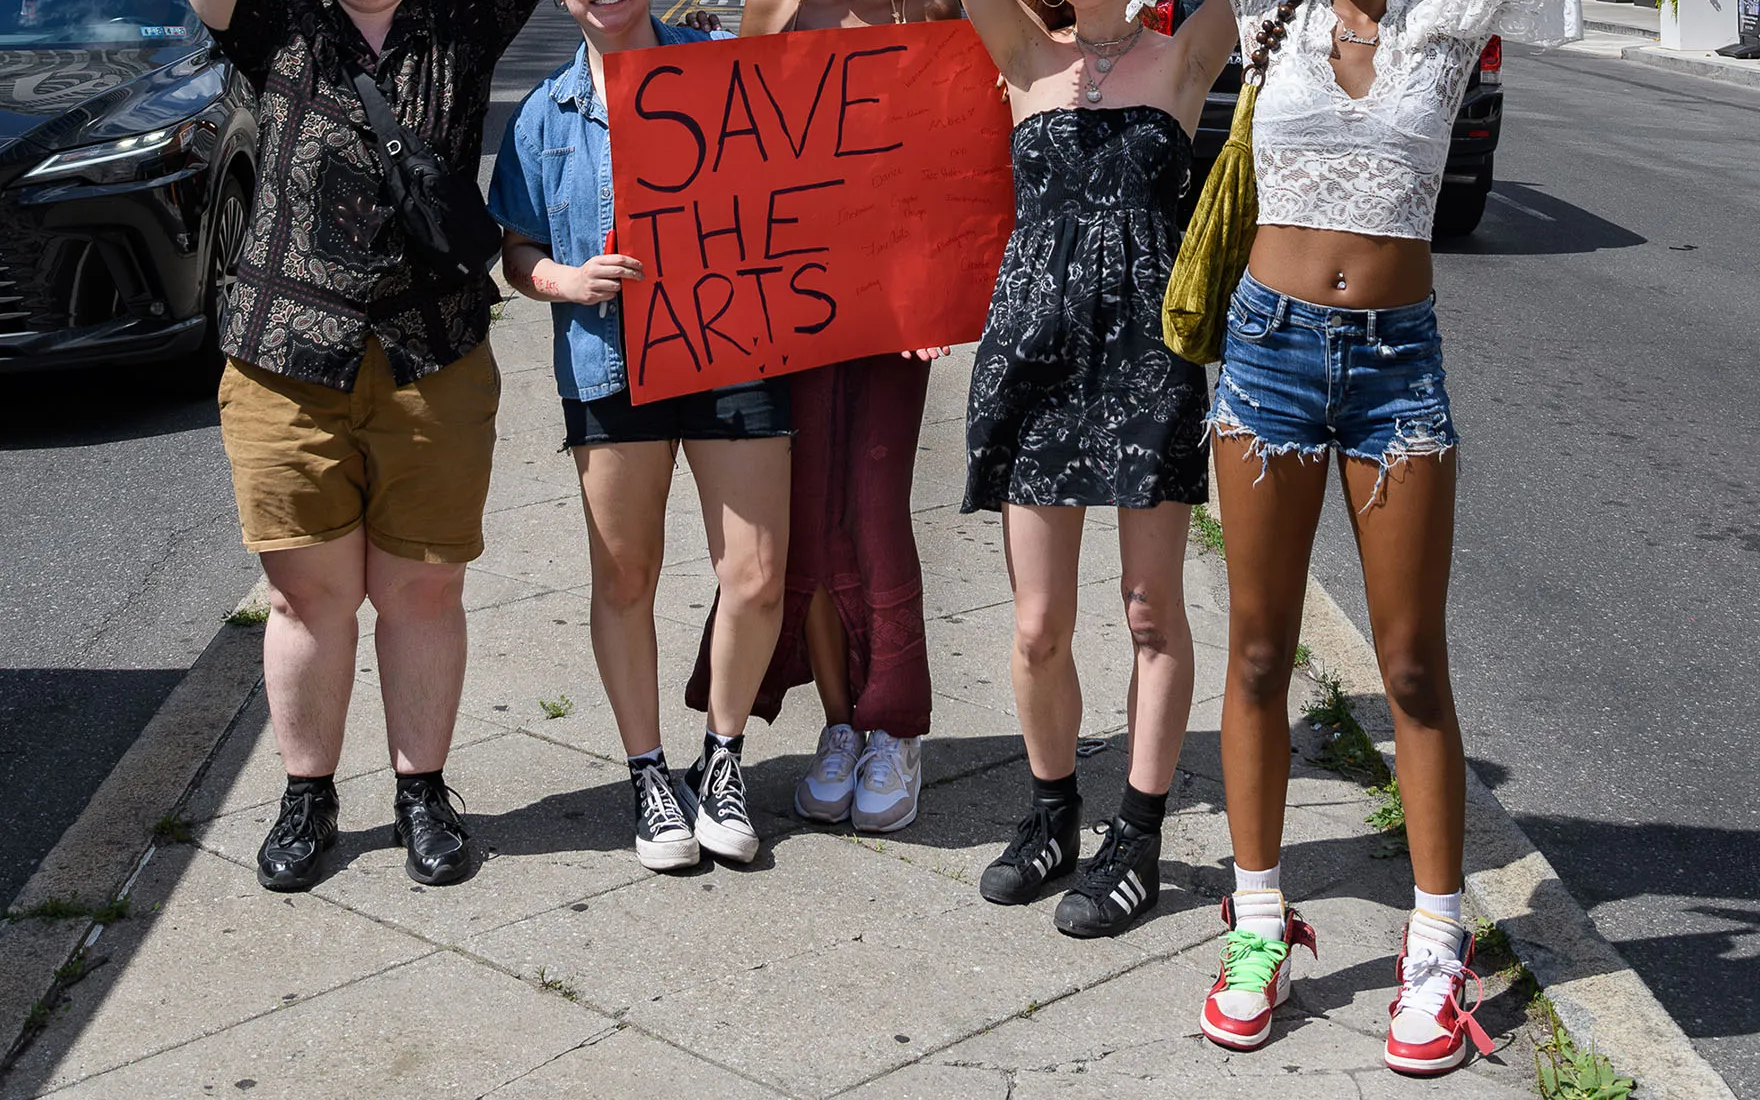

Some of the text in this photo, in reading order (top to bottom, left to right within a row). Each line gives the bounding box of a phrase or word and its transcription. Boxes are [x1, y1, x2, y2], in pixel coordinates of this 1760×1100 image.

[634, 44, 908, 194] SAVE
[628, 178, 845, 279] THE
[638, 262, 838, 387] ARTS
